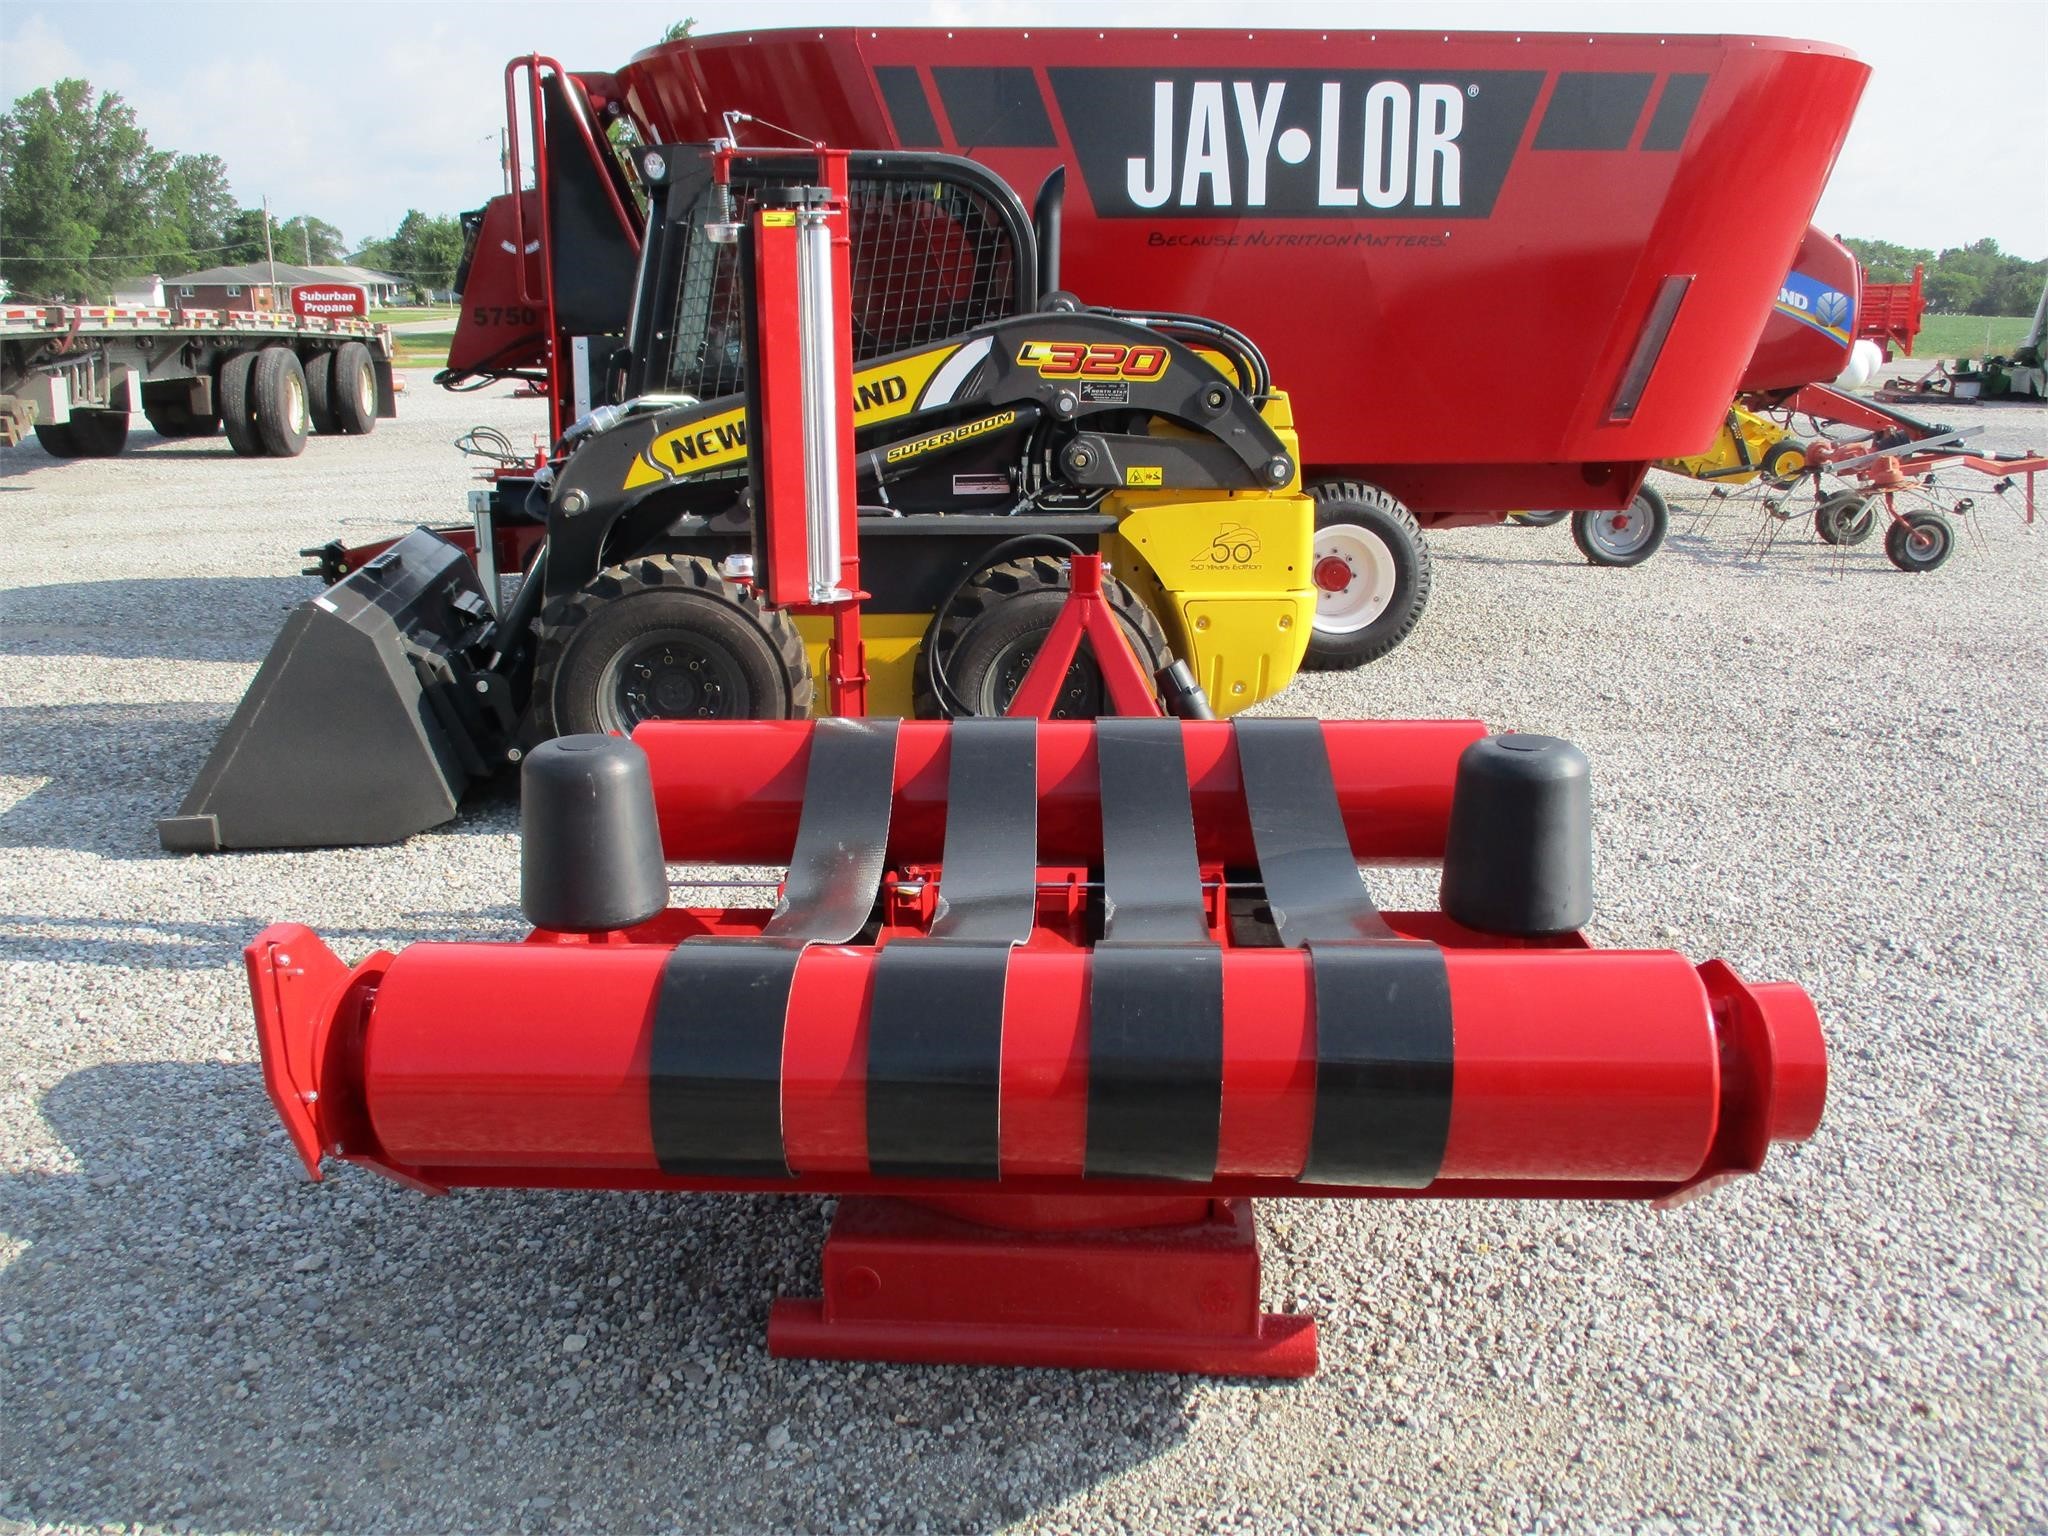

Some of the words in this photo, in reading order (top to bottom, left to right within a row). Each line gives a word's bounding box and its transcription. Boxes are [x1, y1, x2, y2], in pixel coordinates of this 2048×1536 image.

[299, 291, 356, 301] Suburban
[1777, 287, 1808, 311] ND
[304, 303, 354, 313] Propane
[473, 306, 537, 326] 5750
[670, 420, 747, 464] NEW
[888, 430, 953, 460] SUPER
[957, 411, 1013, 438] BOOM
